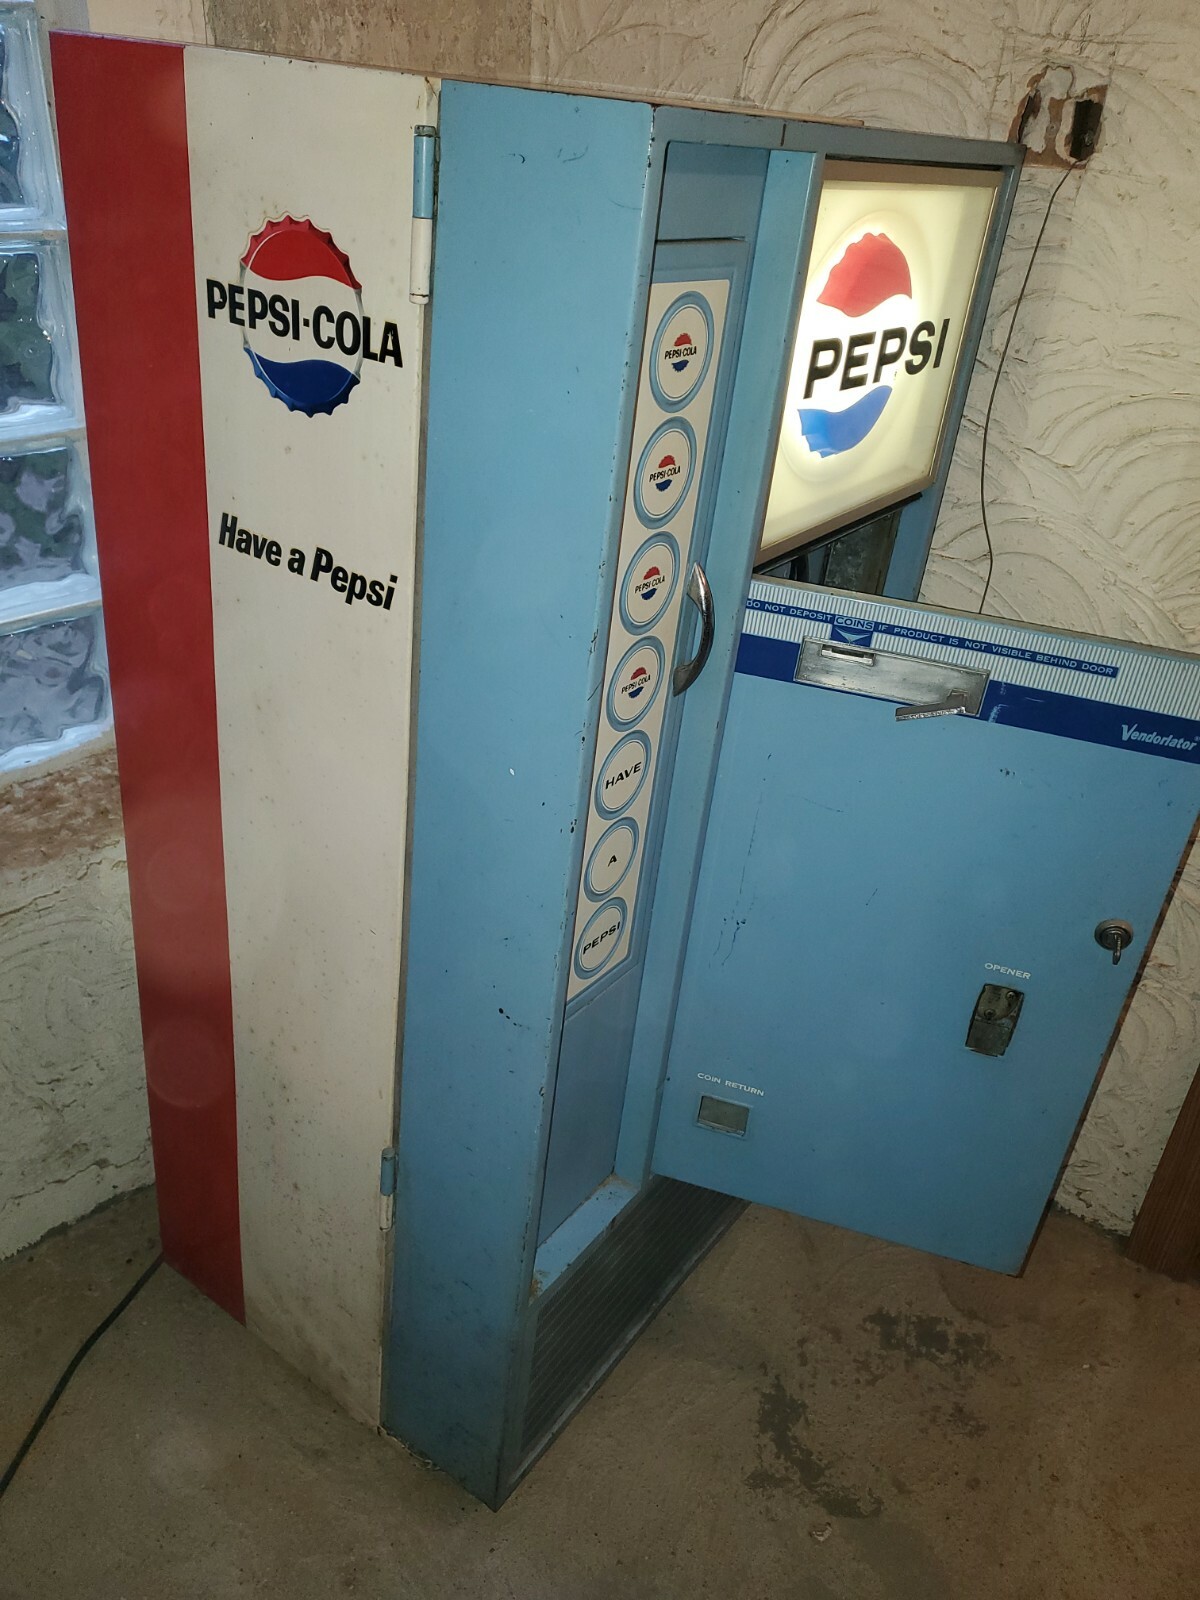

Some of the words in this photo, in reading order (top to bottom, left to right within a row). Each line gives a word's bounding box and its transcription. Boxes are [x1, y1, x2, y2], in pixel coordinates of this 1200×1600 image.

[803, 318, 950, 399] PEPSI
[218, 512, 282, 567] Have
[287, 548, 306, 576] a
[310, 547, 398, 611] Pepsi
[746, 600, 761, 608] DO
[764, 603, 787, 613] NOT
[789, 608, 834, 622] DEPOSIT
[834, 616, 874, 630] COINS
[893, 627, 946, 643] PRODUCT
[948, 637, 959, 646] IS
[964, 641, 988, 650] NOT
[992, 645, 1033, 660] VISIBLE
[1036, 654, 1078, 668] BEHIND
[1081, 663, 1114, 675] DOOR
[1121, 723, 1197, 751] Vendorlator
[605, 762, 642, 790] HAVE
[607, 854, 618, 867] A
[582, 921, 621, 955] PEPSI
[984, 962, 1031, 980] OPENER
[697, 1072, 721, 1084] COIN
[724, 1080, 765, 1097] RETURN
